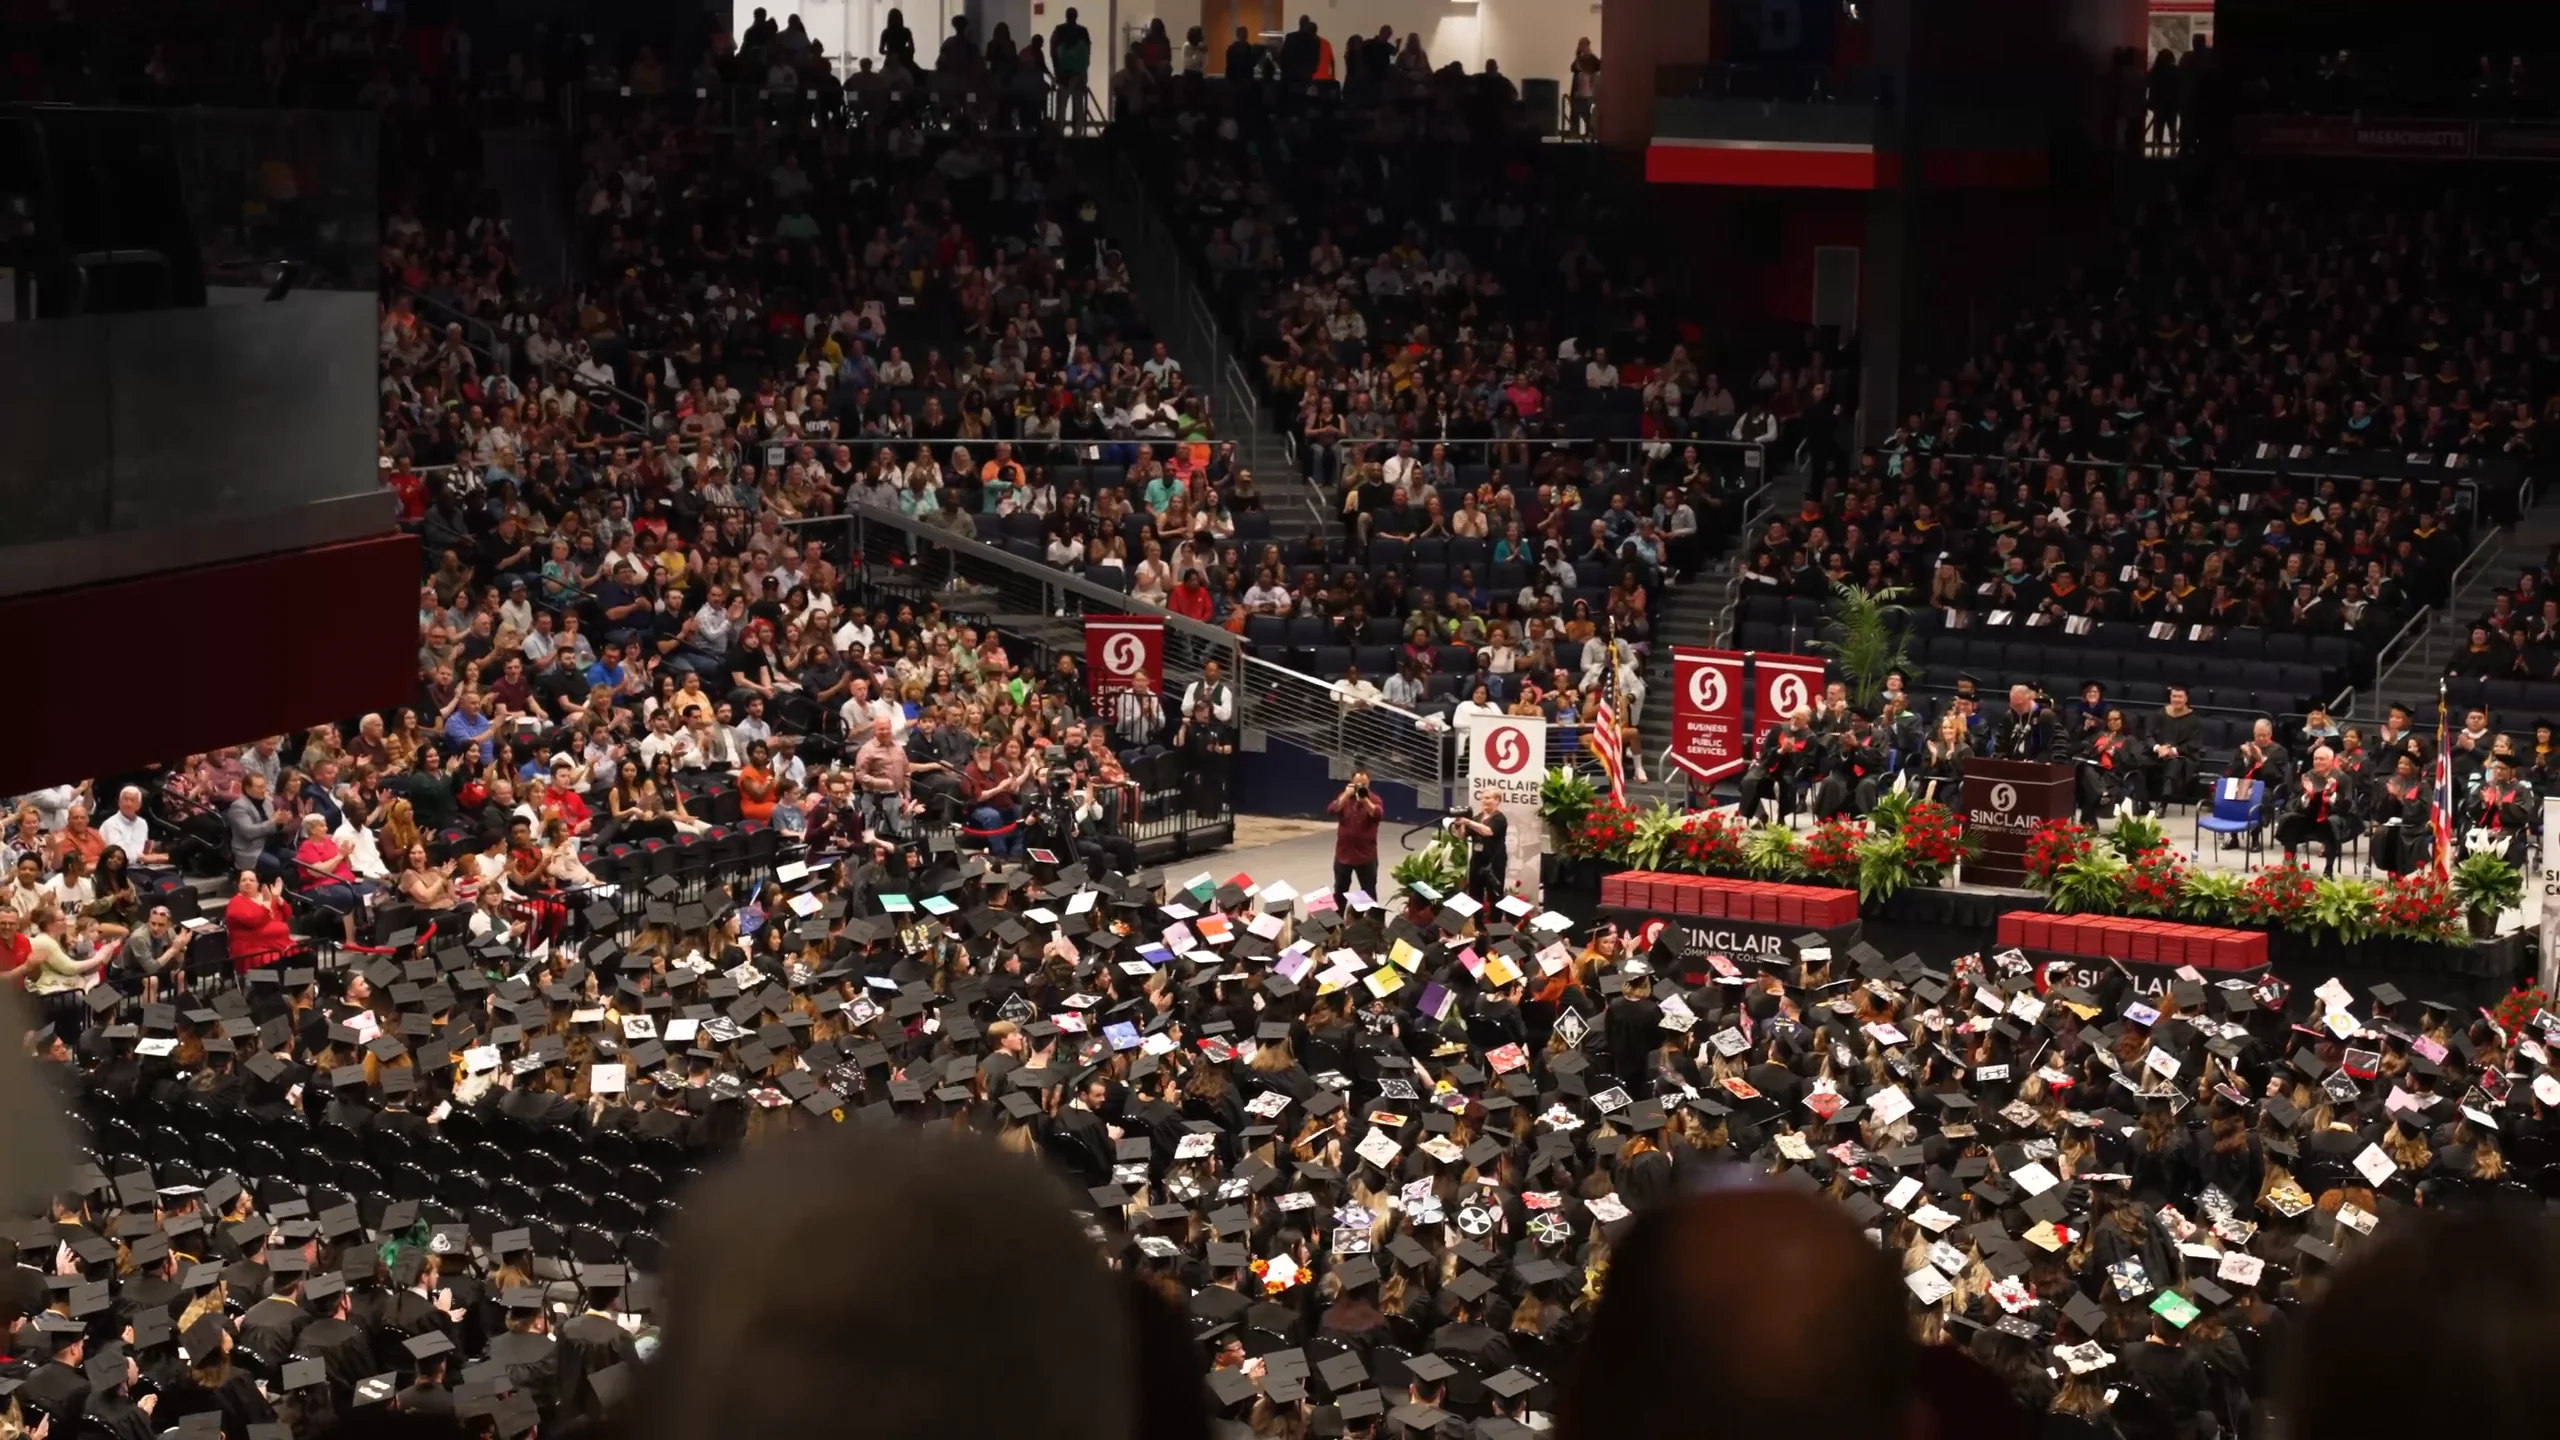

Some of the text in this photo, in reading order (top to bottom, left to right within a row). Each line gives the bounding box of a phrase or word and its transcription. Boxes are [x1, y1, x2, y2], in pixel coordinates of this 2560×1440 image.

[1687, 722, 1728, 733] BUSINESS
[1691, 738, 1723, 748] PUBLIC
[1687, 745, 1728, 756] SERVICES
[1474, 777, 1539, 792] SINCLAIR
[1474, 791, 1538, 805] CLEGE
[1970, 809, 2040, 829] SINCLAIR
[1970, 823, 2007, 833] COMMUNITY
[2077, 969, 2173, 997] SILAI
